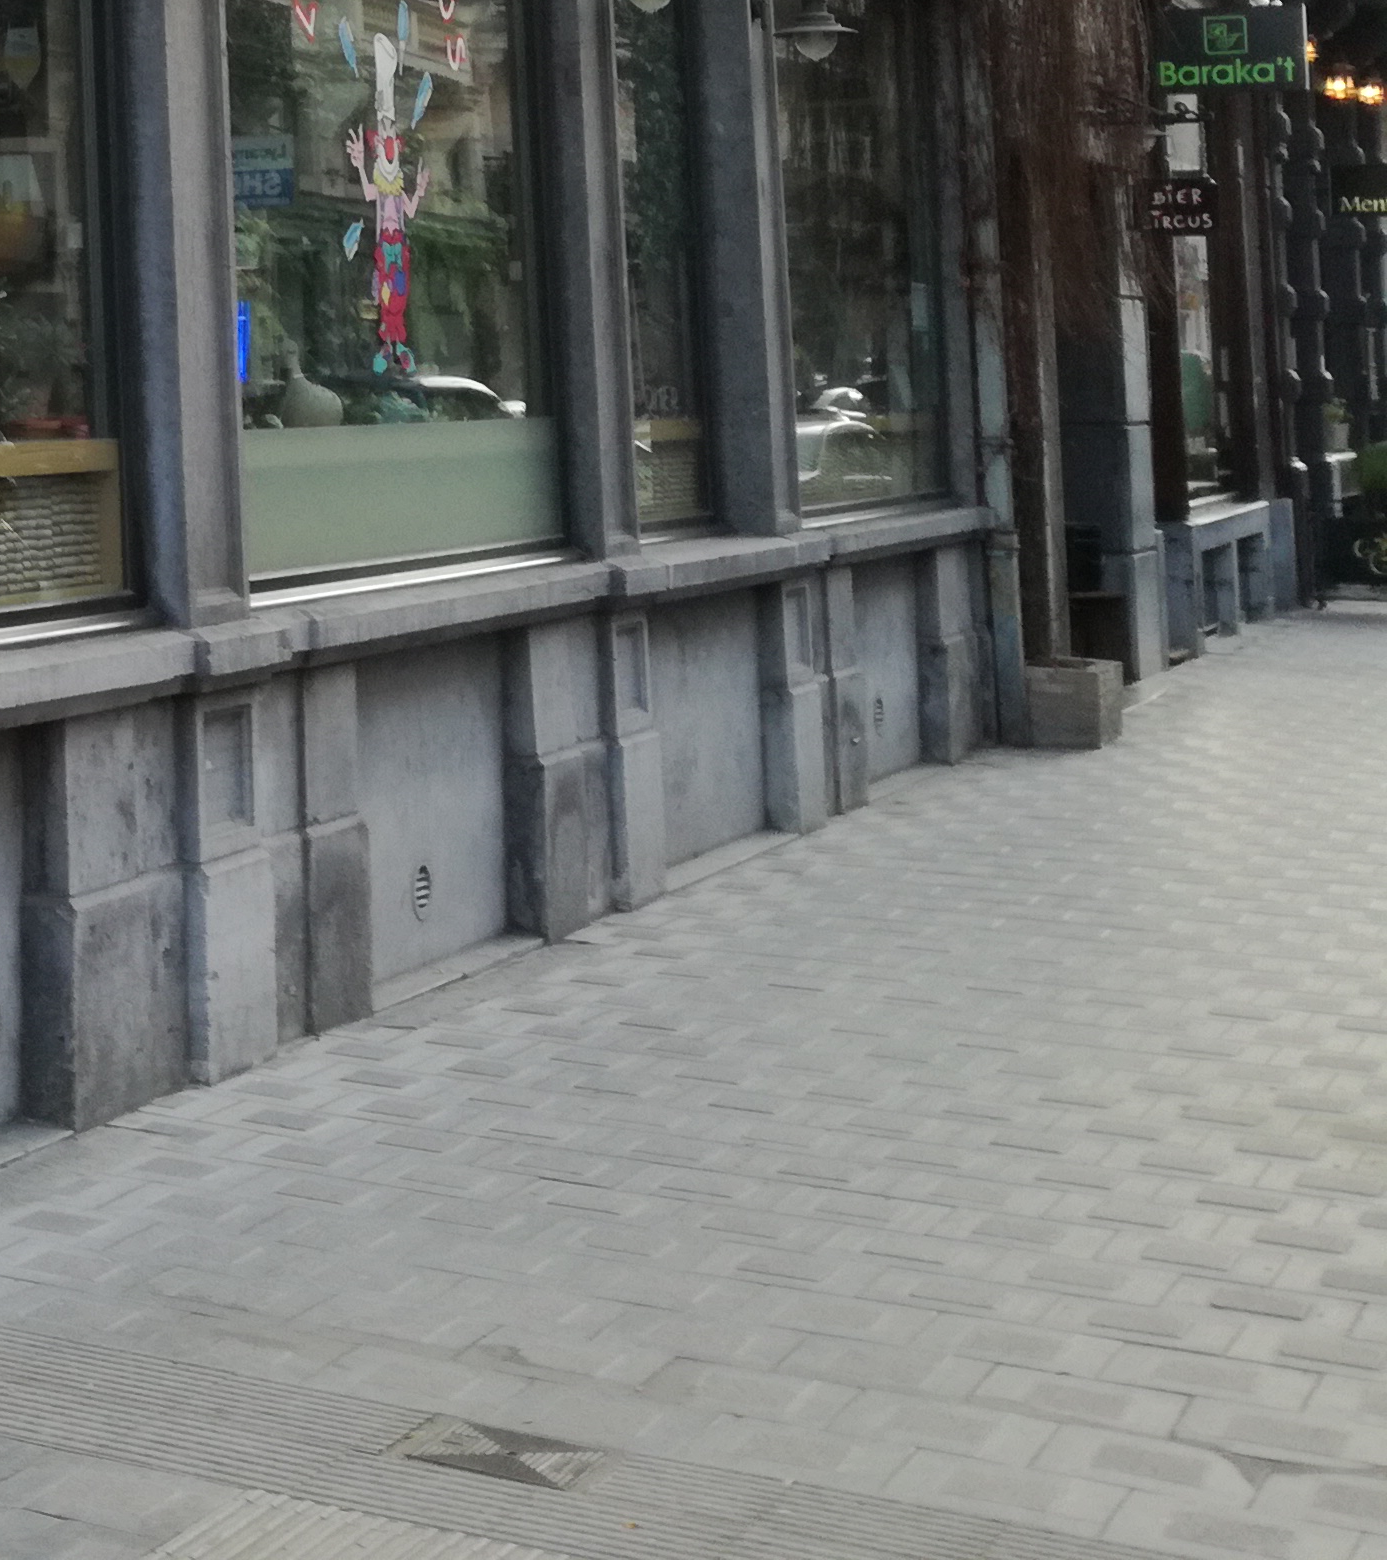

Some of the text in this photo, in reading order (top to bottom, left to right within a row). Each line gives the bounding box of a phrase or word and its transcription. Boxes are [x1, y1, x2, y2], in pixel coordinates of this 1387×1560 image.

[1158, 55, 1296, 87] Baraka't
[1151, 184, 1203, 207] BIER
[1142, 211, 1214, 231] IRCUS
